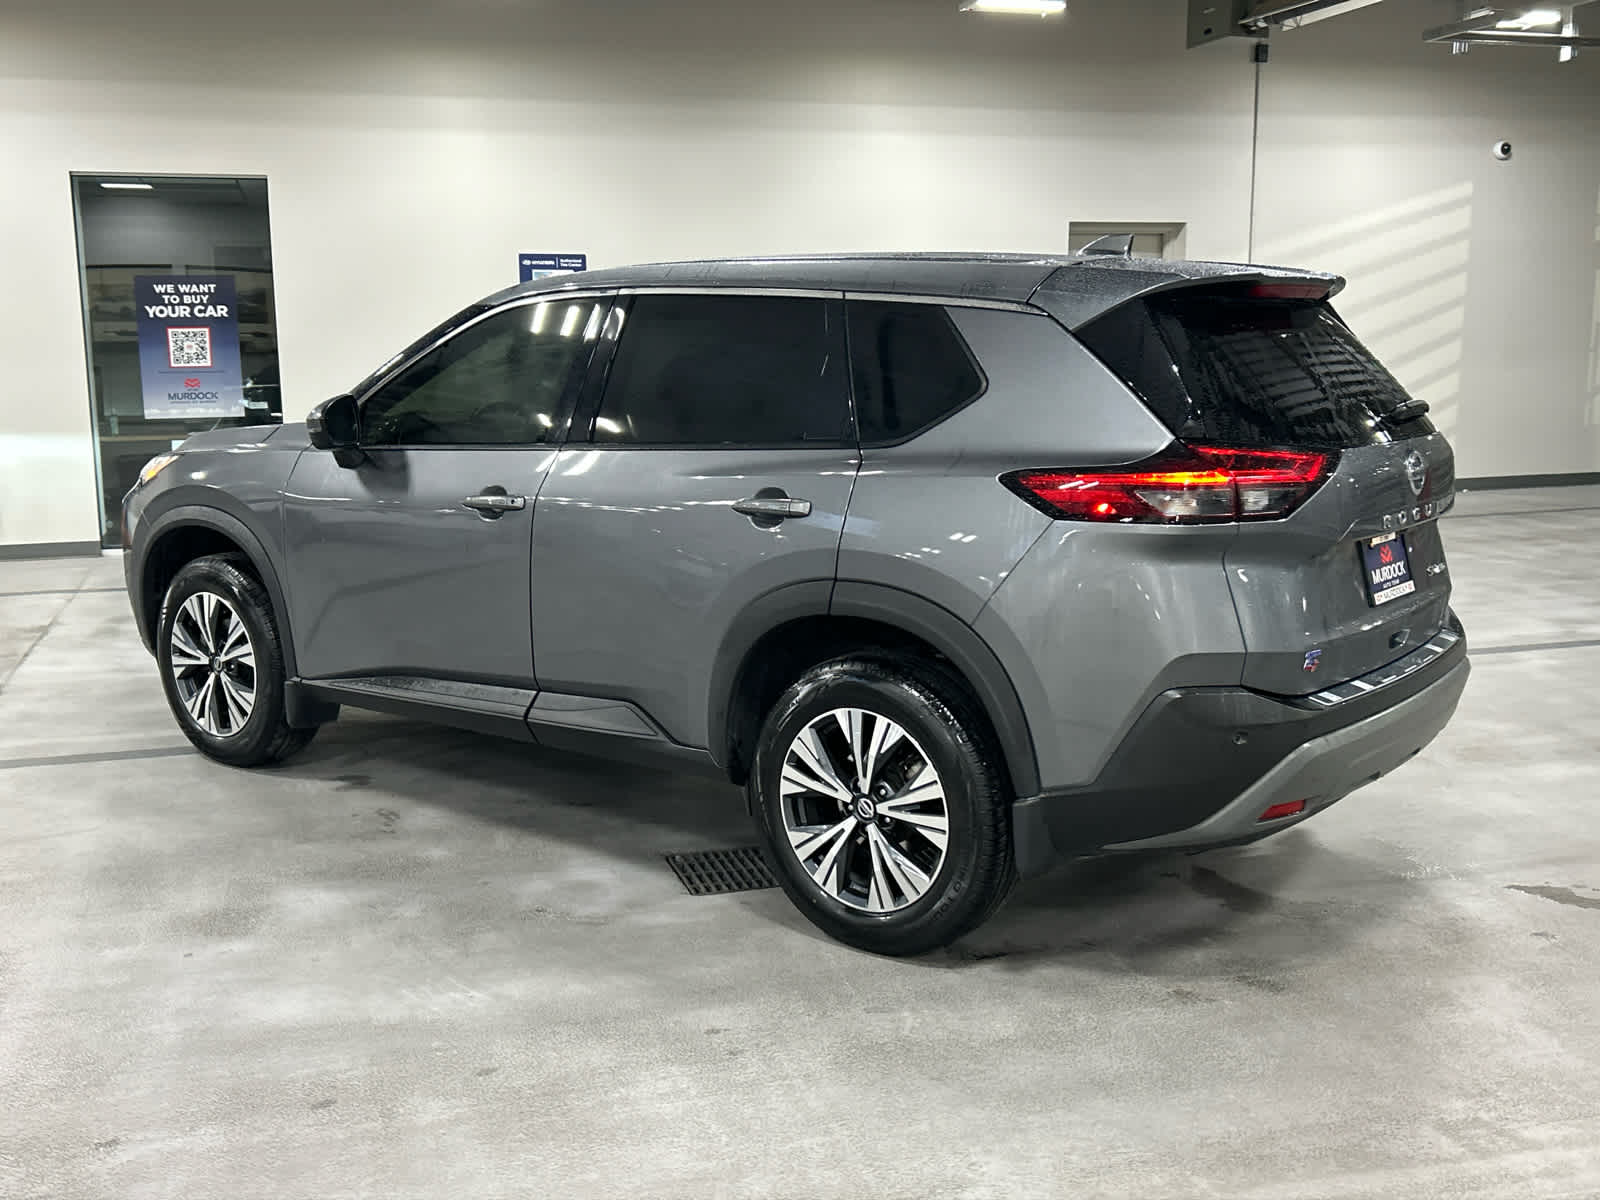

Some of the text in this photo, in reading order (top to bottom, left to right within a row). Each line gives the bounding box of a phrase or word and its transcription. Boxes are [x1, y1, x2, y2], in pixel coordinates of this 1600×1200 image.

[153, 284, 216, 293] WE WANT
[161, 294, 209, 304] TO BUY
[143, 304, 229, 318] YOUR CAR
[167, 391, 219, 401] MURDOCK
[1371, 560, 1406, 585] MURDOCK
